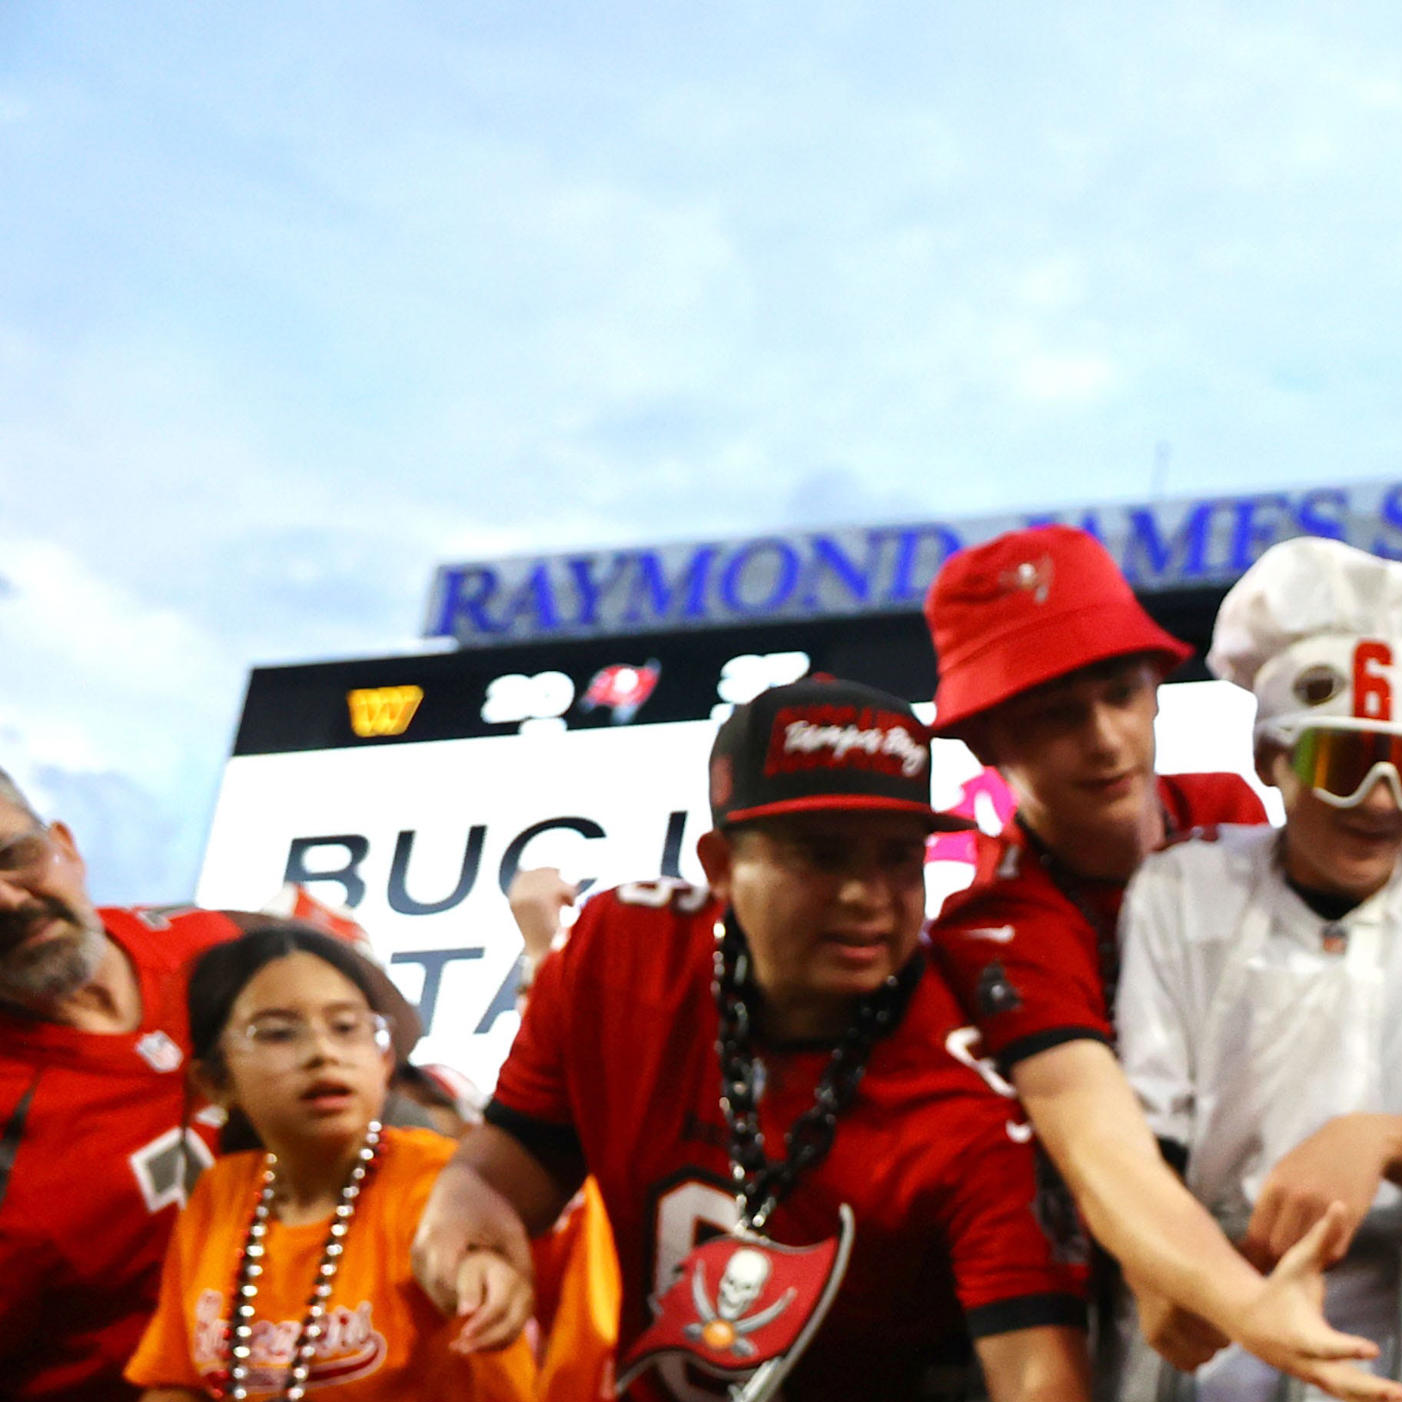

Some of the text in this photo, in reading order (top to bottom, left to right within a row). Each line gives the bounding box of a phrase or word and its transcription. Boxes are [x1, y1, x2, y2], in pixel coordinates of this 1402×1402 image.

[436, 520, 963, 637] RAYMOND
[1022, 487, 1348, 581] MES
[1351, 639, 1394, 722] 6
[283, 816, 607, 917] BUC
